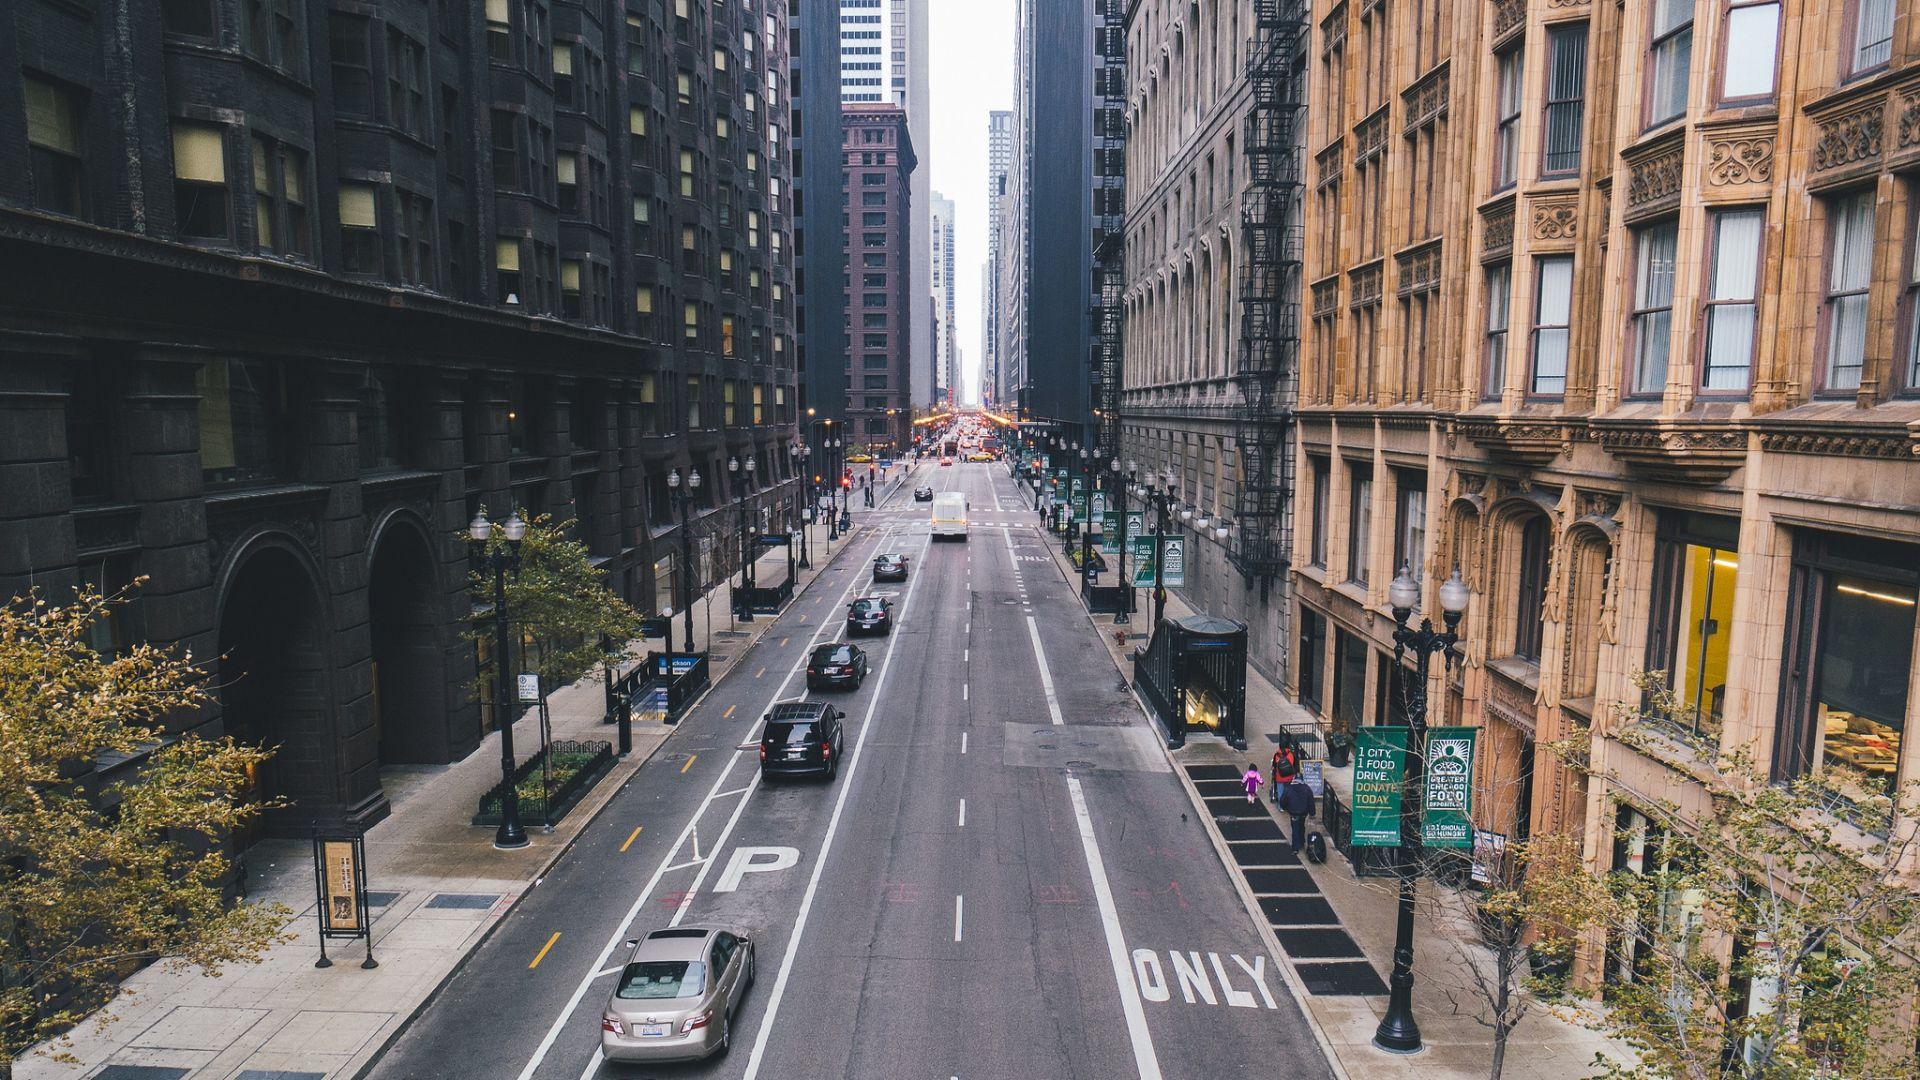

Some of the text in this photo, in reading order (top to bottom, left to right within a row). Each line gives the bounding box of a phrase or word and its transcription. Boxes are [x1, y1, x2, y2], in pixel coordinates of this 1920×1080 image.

[1359, 747, 1392, 759] 1 CITY,
[1357, 758, 1395, 770] 1 FOOD
[1356, 770, 1389, 780] DRIVE.
[1429, 791, 1464, 801] FOOD
[713, 846, 800, 892] P
[1132, 948, 1278, 1010] ONLY
